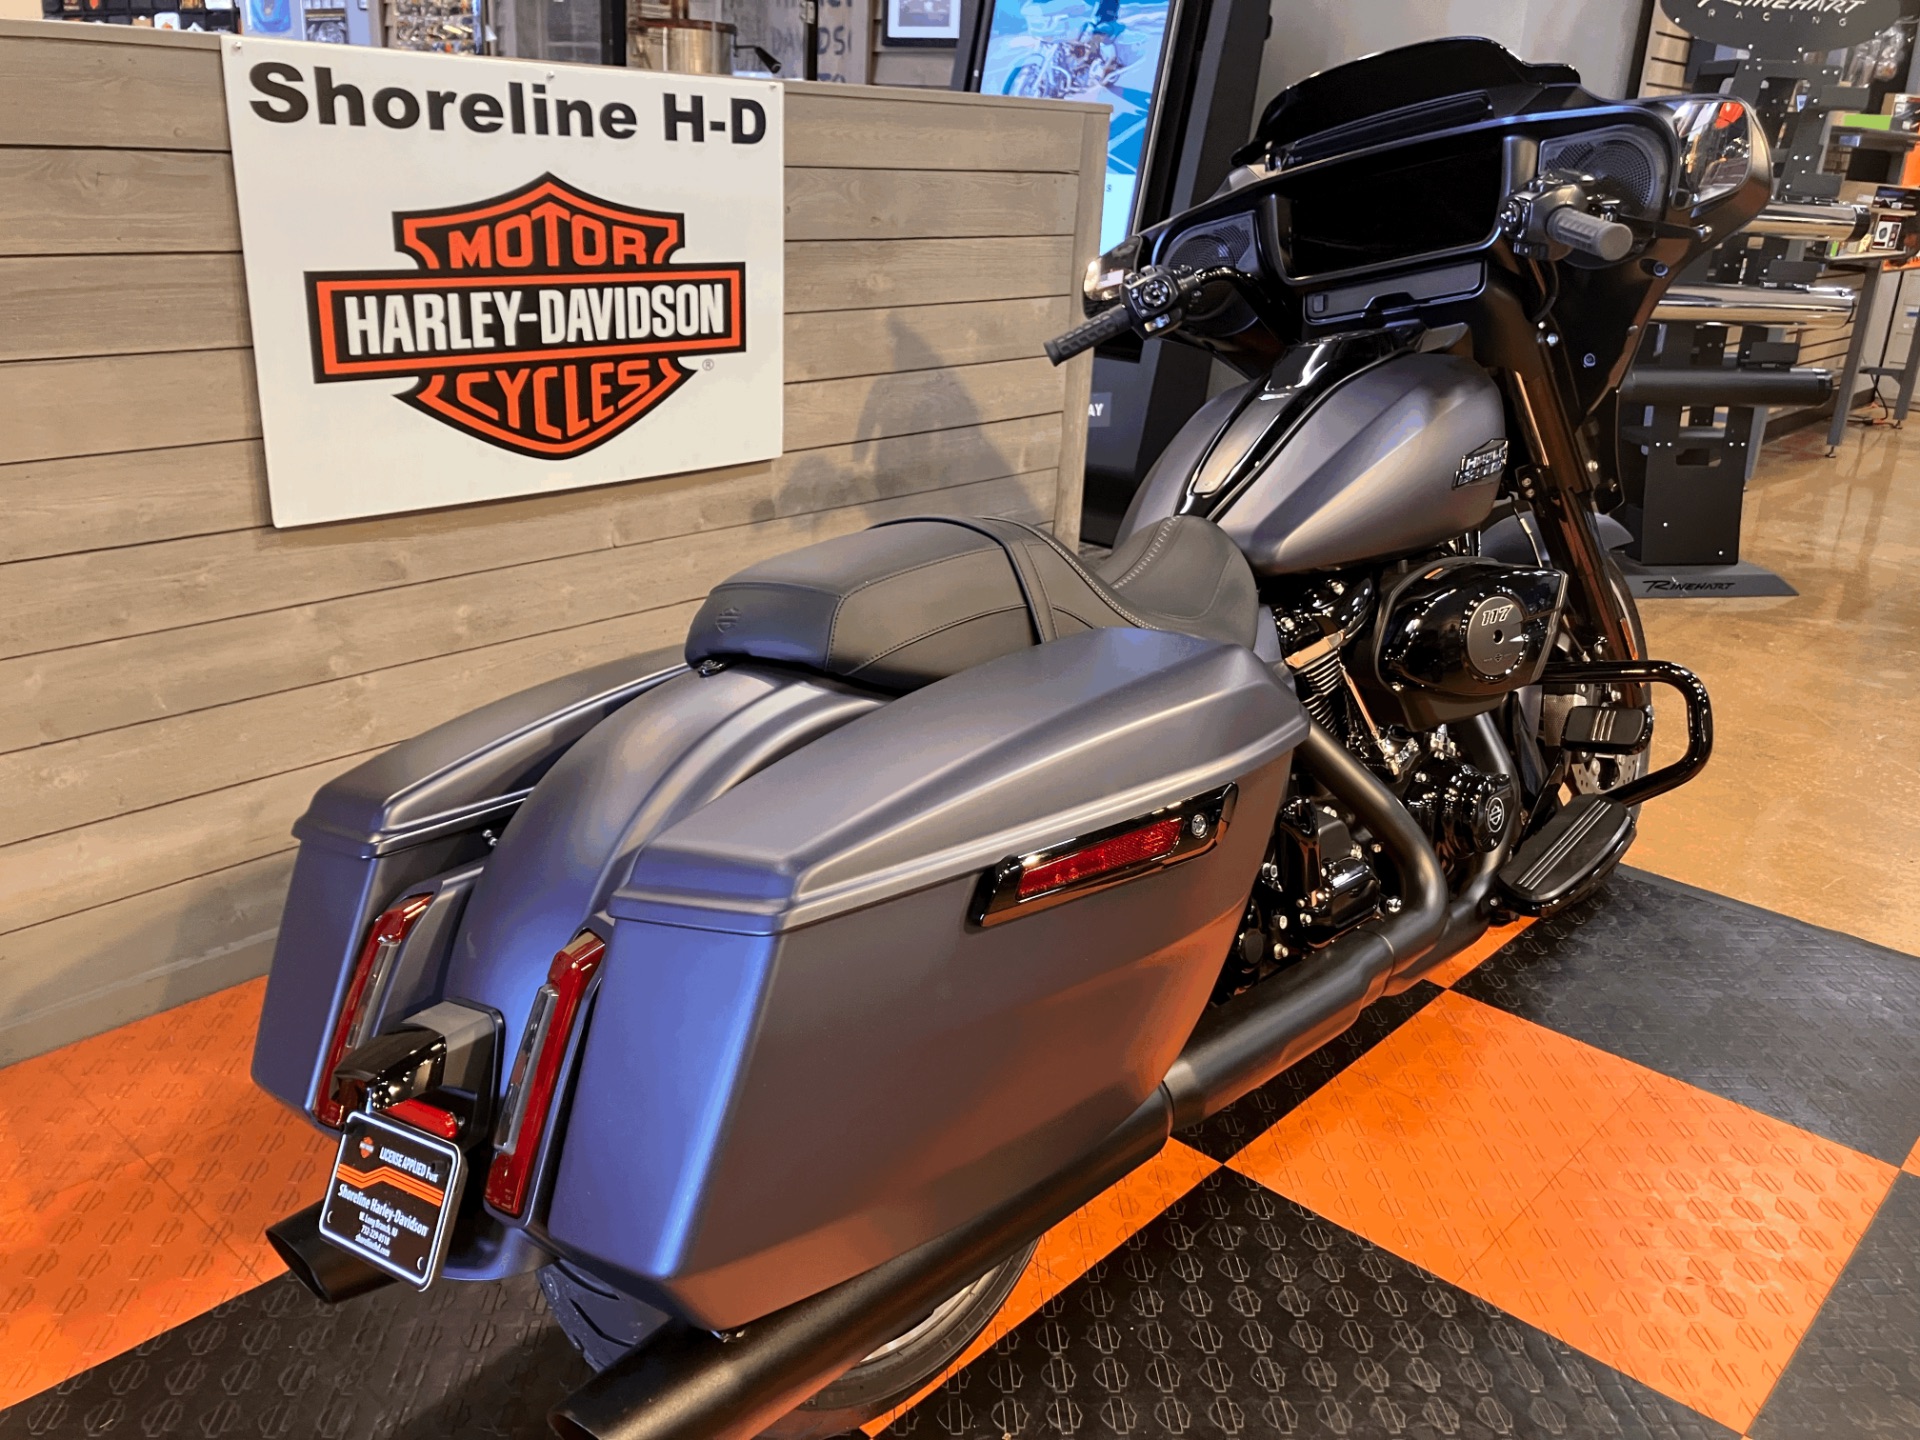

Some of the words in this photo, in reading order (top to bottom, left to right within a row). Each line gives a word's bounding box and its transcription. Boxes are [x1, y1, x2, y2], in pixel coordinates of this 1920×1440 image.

[1707, 8, 1848, 27] RACING
[249, 61, 638, 140] Shoreline
[663, 92, 767, 145] H-D
[448, 201, 647, 269] MOTOR
[344, 283, 725, 357] HARLEY-DAVIDSON
[455, 357, 651, 440] CYCLES
[1642, 580, 1736, 594] RINEHART
[1481, 604, 1514, 627] 117
[379, 1146, 405, 1166] LICENSE
[400, 1155, 427, 1178] APPLIED
[338, 1184, 371, 1210] Shoreline
[369, 1197, 430, 1238] Harley-Davidson
